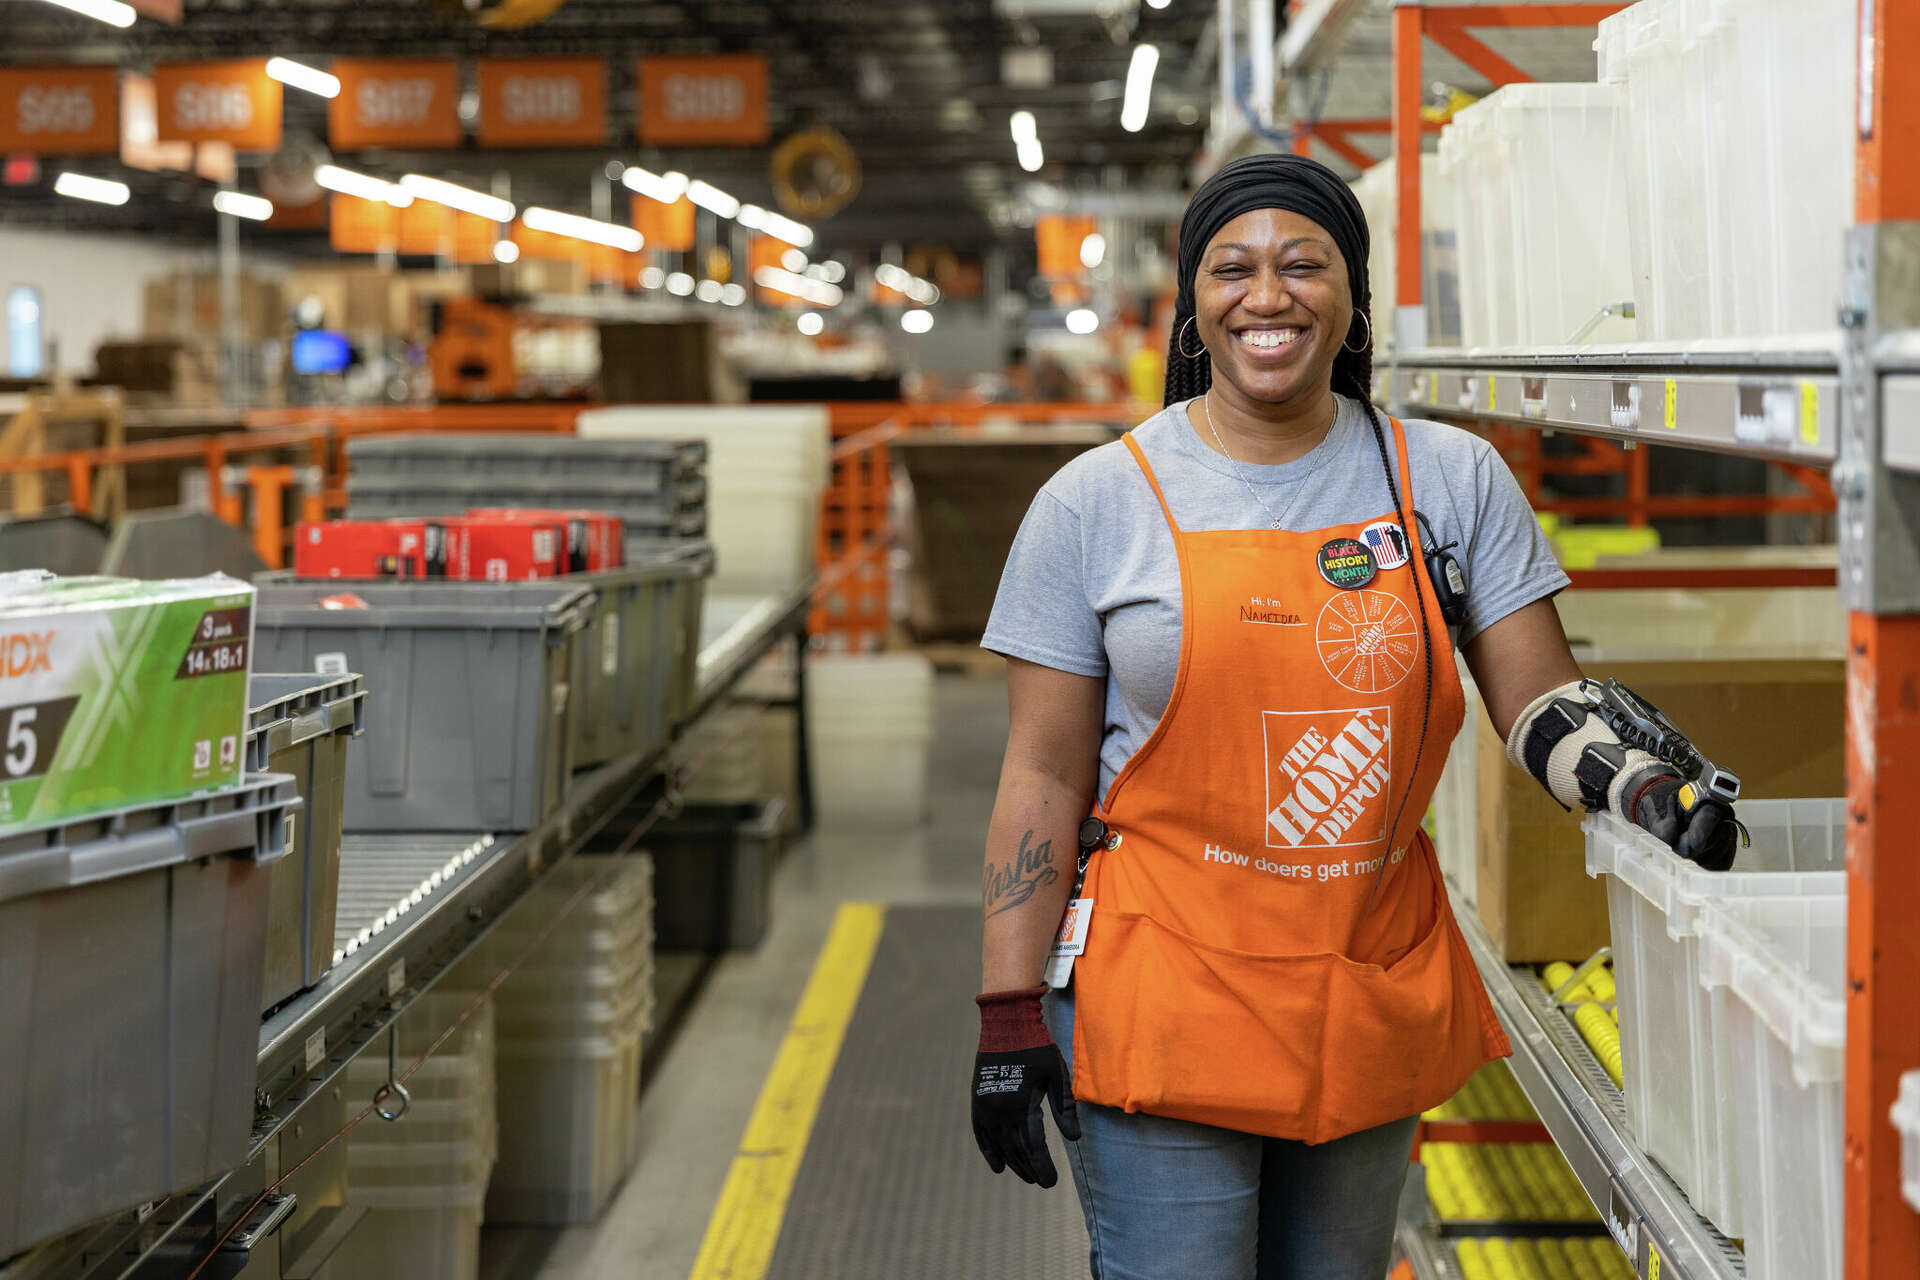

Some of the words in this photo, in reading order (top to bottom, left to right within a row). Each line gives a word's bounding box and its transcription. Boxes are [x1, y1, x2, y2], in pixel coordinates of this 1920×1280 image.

[1325, 554, 1368, 570] HISTORY
[1327, 545, 1360, 558] BLACK
[1332, 566, 1369, 579] MONTH
[1267, 598, 1281, 607] I'm
[203, 615, 213, 638] 3
[4, 707, 38, 777] 5
[1279, 726, 1328, 781] THE
[1268, 710, 1389, 846] HOME
[1315, 757, 1390, 846] DEPOT
[1204, 844, 1249, 867] How
[1255, 857, 1313, 879] doers
[1317, 860, 1350, 882] get
[1354, 856, 1386, 875] mor
